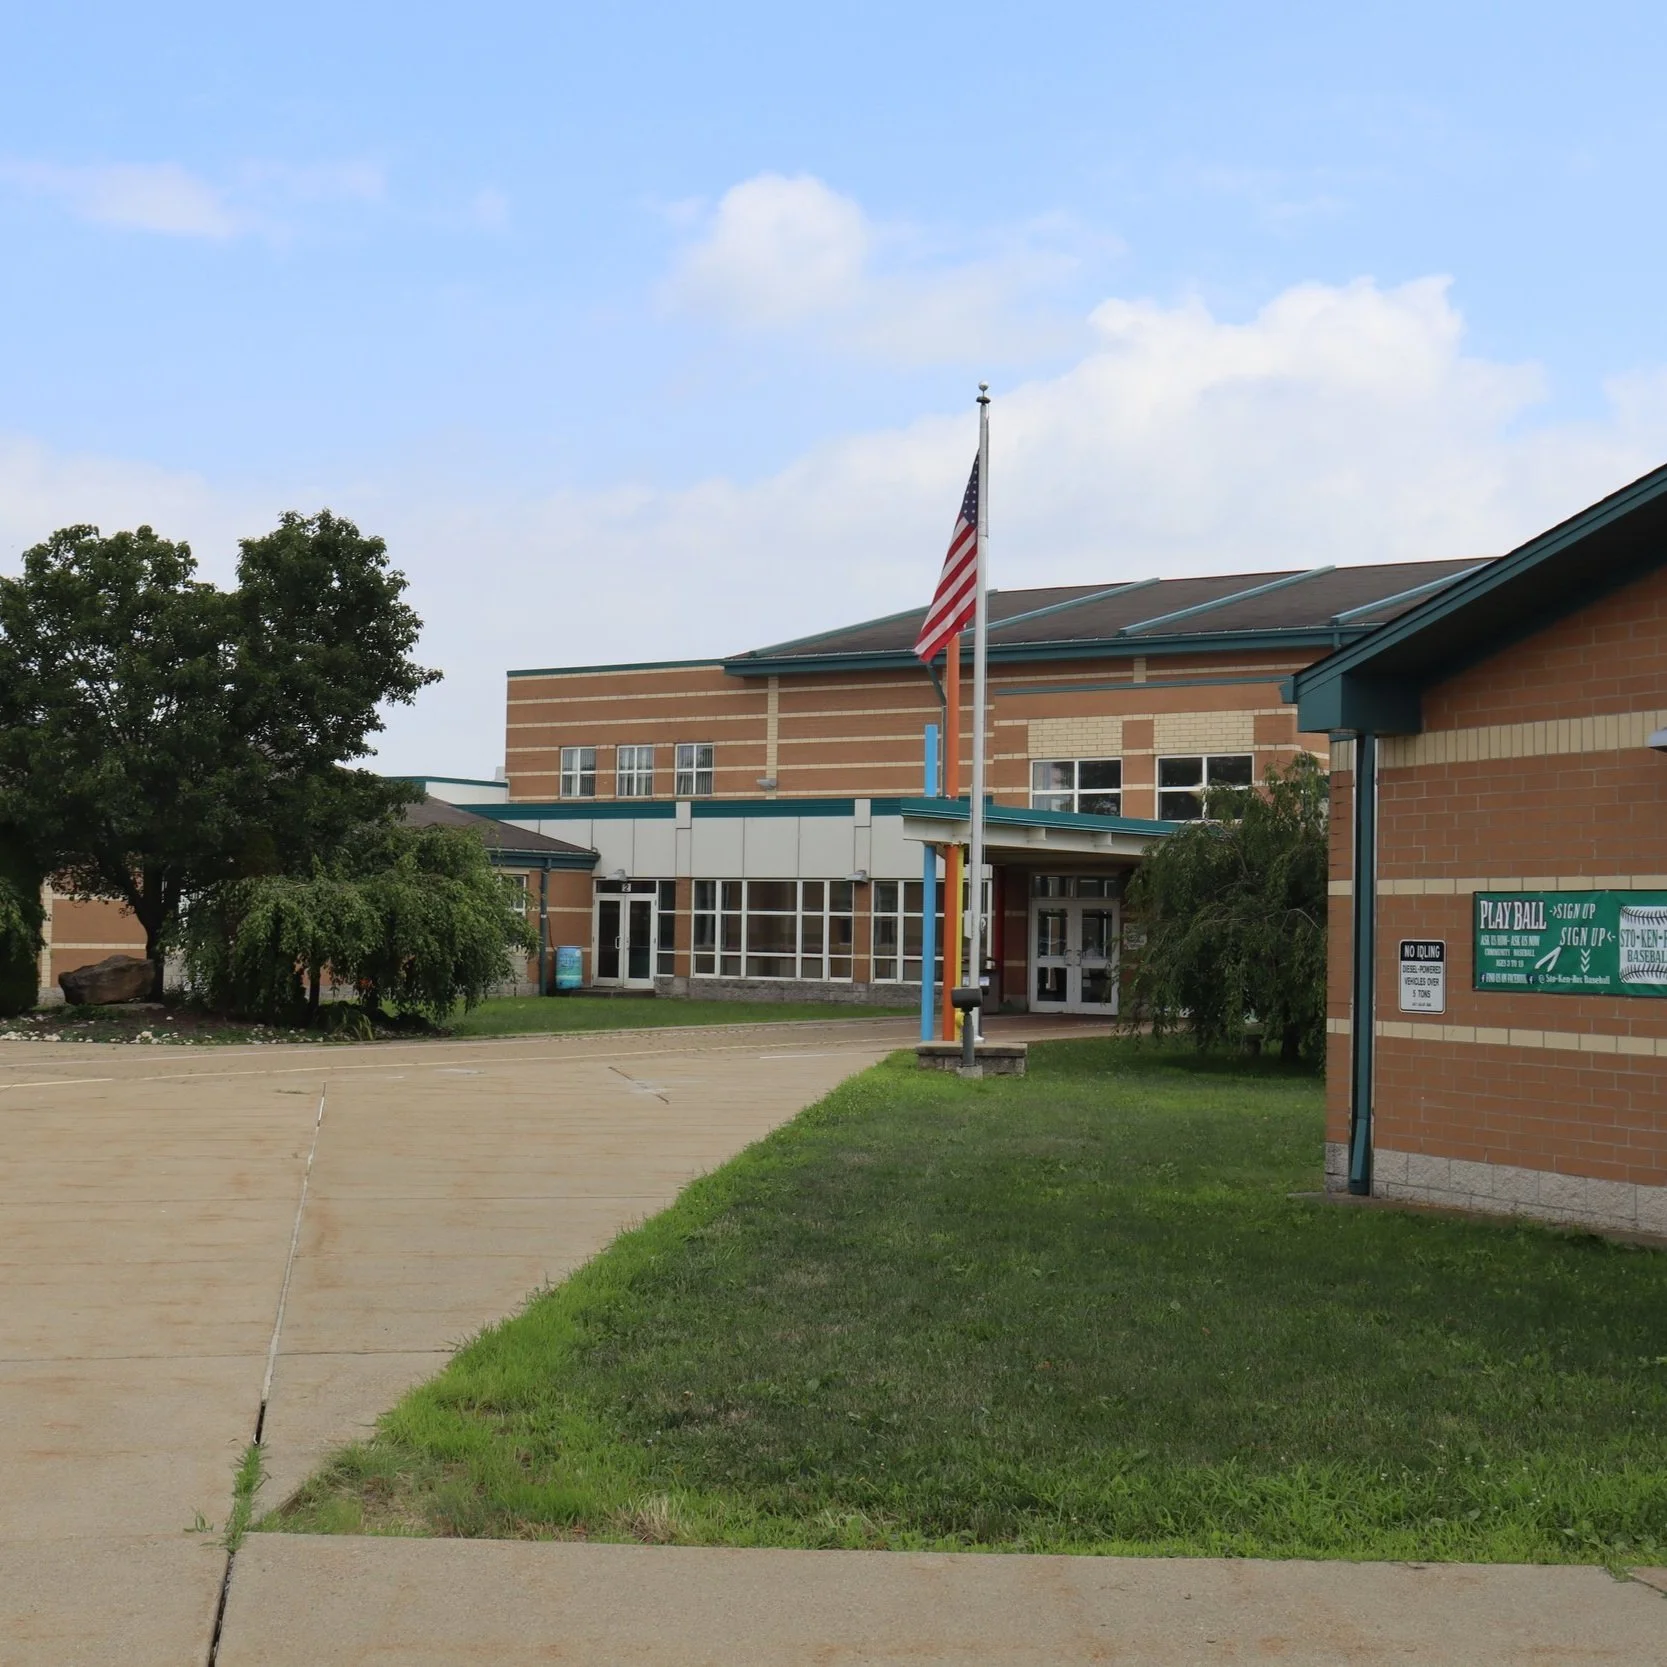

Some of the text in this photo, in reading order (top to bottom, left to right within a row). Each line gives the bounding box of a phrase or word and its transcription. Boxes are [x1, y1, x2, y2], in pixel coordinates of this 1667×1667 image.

[1480, 901, 1547, 930] PLAY BALL
[1556, 903, 1596, 919] SIGN UP
[1559, 927, 1606, 947] SIGN UP
[1404, 945, 1415, 958] NO
[1404, 977, 1439, 986] VEHICLES OVER
[1418, 990, 1431, 998] TONS
